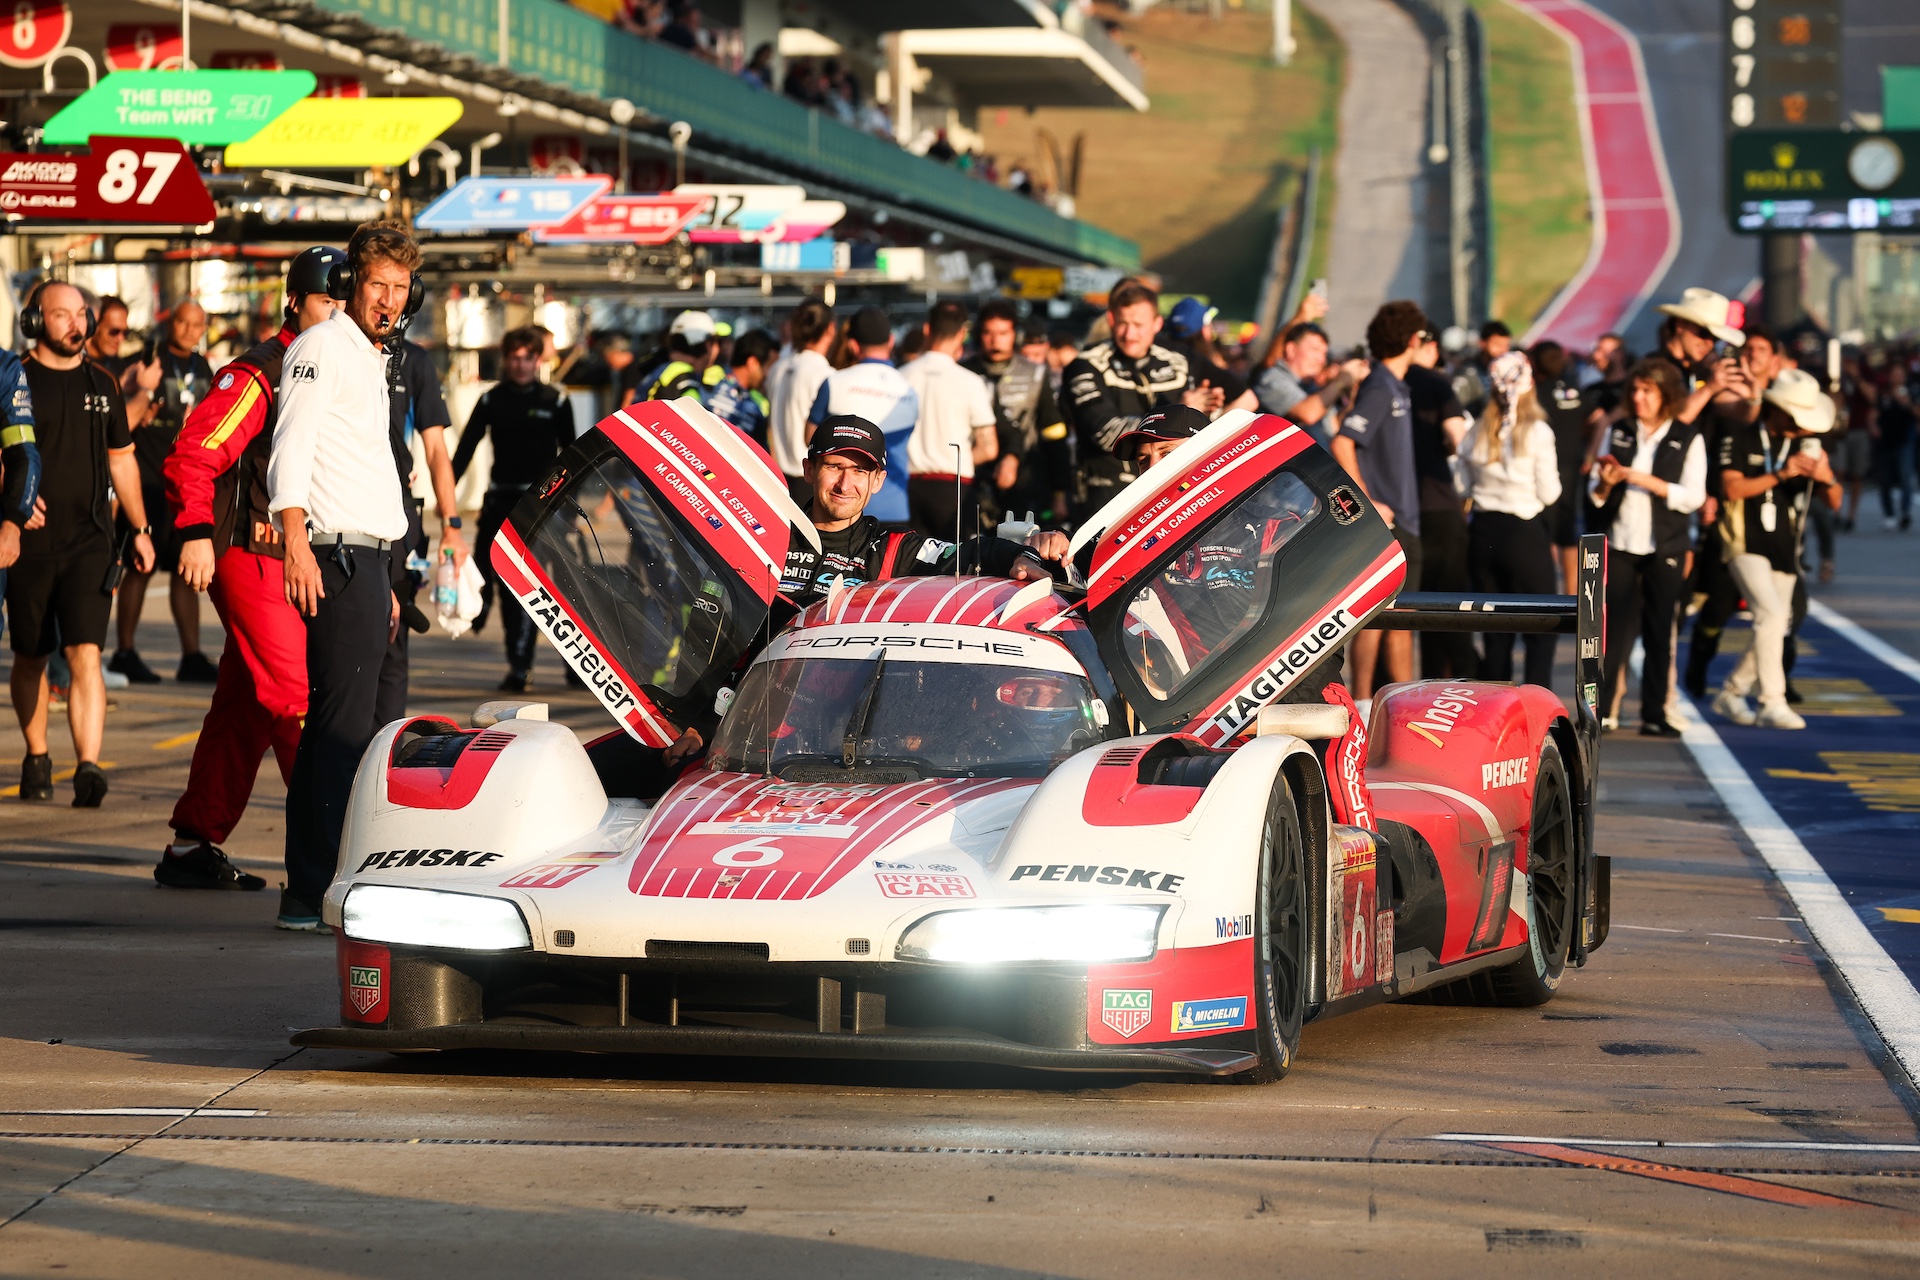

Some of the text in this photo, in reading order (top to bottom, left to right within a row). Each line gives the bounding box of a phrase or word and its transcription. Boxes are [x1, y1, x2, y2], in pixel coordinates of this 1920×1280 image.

[12, 2, 36, 49] 8
[1732, 15, 1755, 50] 6
[1731, 53, 1755, 87] 7
[119, 88, 212, 106] THE BEND
[225, 94, 272, 120] 31
[116, 106, 218, 124] Team WRT
[1731, 92, 1755, 127] 8
[98, 149, 182, 205] 87
[1743, 169, 1824, 190] ROLEX
[21, 196, 77, 208] LEXUS
[529, 190, 572, 211] 15
[630, 206, 678, 227] 20
[293, 365, 315, 379] FIA
[649, 421, 707, 472] L. VANTHOOR
[1191, 433, 1261, 483] L. VANTHOOR
[653, 462, 710, 518] M. CAMPBELL
[719, 487, 758, 526] K. ESTRE
[1126, 496, 1171, 534] K. ESTRE
[1155, 486, 1225, 540] M. CAMPBELL
[254, 522, 279, 545] PIT
[786, 551, 815, 563] nsys
[1583, 548, 1600, 573] Ansys
[785, 636, 1024, 657] PORSCHE
[1406, 687, 1478, 749] Ansys
[1482, 757, 1529, 790] PENSKE
[729, 809, 845, 820] Ansys
[356, 848, 505, 874] PENSKE
[712, 836, 784, 867] 6
[1342, 837, 1373, 866] DHL
[506, 866, 593, 886] HY
[876, 860, 912, 870] FIA
[883, 874, 961, 885] HYPER
[887, 882, 968, 897] CAR
[1008, 864, 1186, 894] PENSKE
[1216, 915, 1244, 938] Mobil
[1245, 914, 1252, 936] 1
[1351, 881, 1366, 980] 6
[352, 970, 377, 986] TAG
[351, 988, 378, 1011] HEUER
[1107, 993, 1148, 1007] TAG
[1105, 1011, 1148, 1034] HEUER
[1194, 1007, 1240, 1022] MICHELIN
